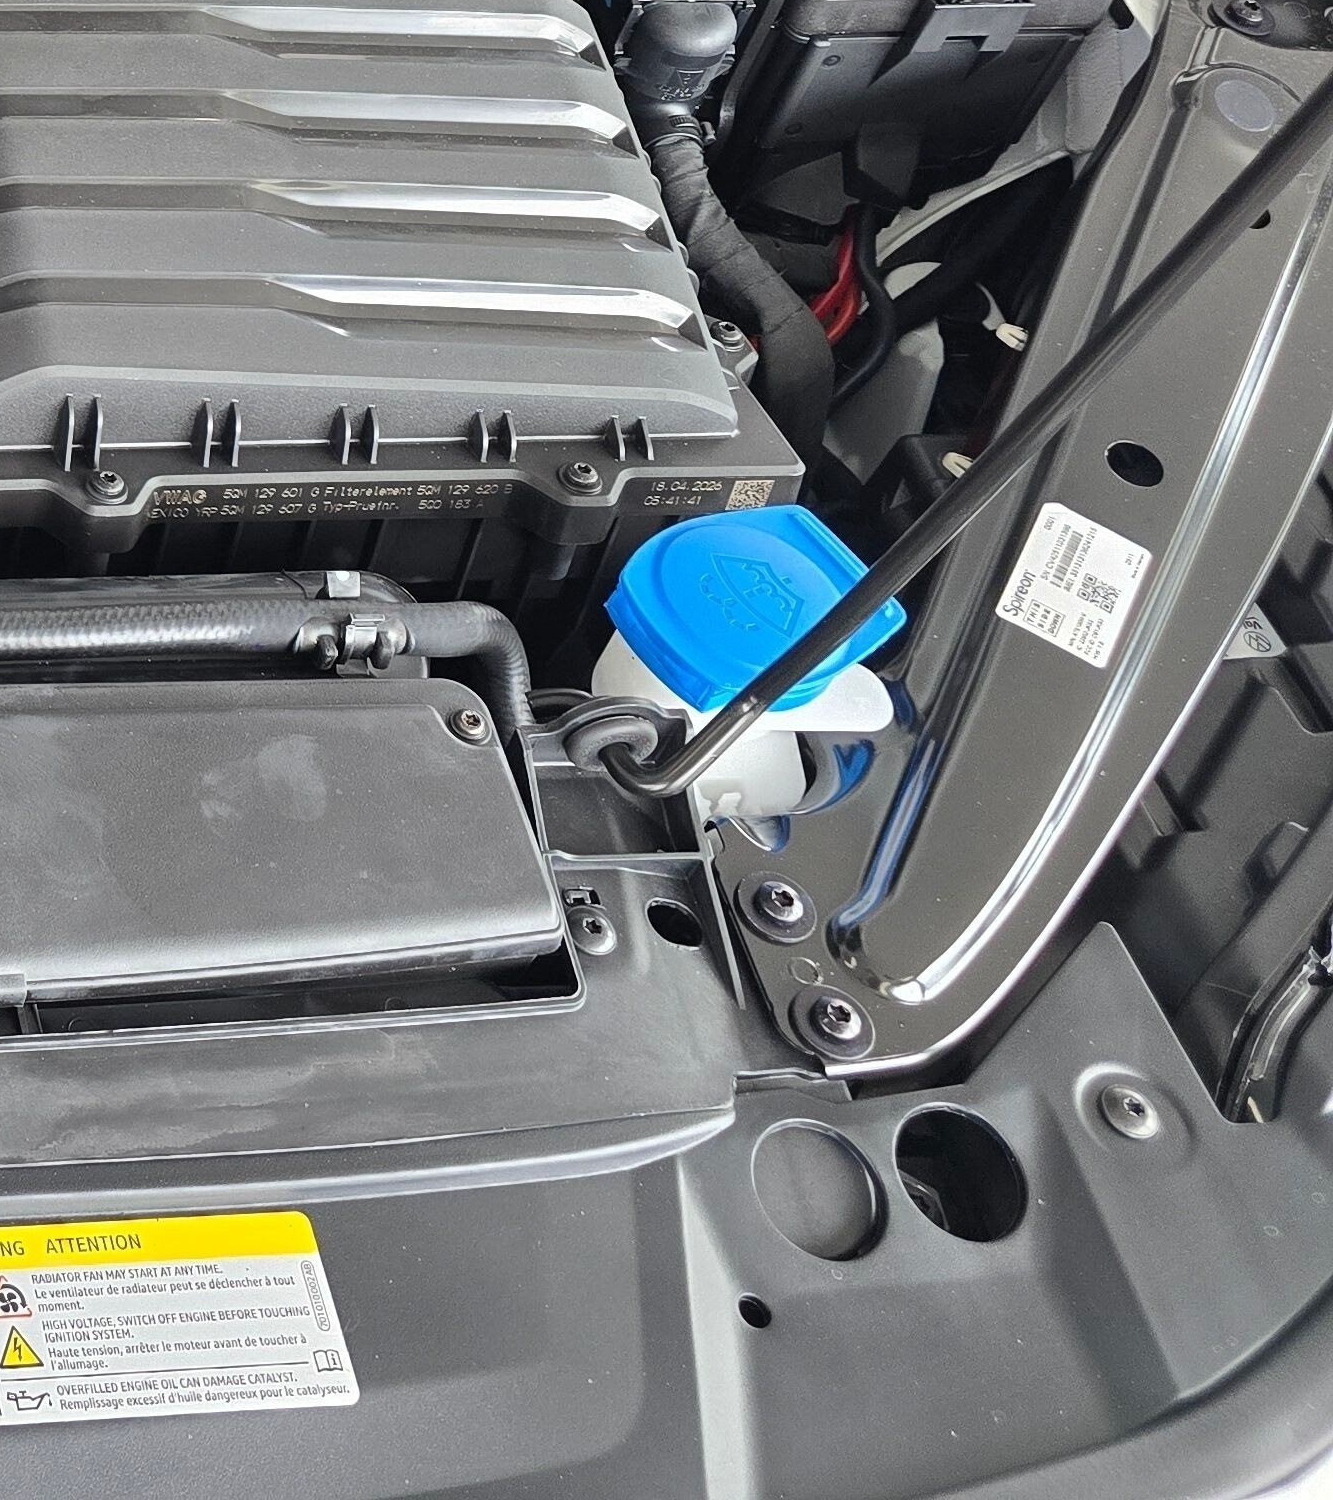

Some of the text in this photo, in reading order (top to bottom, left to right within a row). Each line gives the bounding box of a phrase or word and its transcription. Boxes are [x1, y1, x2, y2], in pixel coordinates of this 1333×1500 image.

[150, 489, 207, 506] VWAG
[255, 487, 276, 499] 129
[281, 487, 303, 498] 601
[311, 486, 320, 498] G
[323, 484, 413, 499] Filterelement
[448, 484, 470, 495] 129
[475, 484, 498, 494] 620
[644, 495, 702, 506] 05:41:41
[252, 503, 273, 515] 129
[278, 503, 302, 514] 607
[307, 503, 317, 514] G
[1001, 567, 1037, 618] Spireon
[1026, 602, 1040, 623] THIS
[1036, 607, 1051, 628] SIDE
[1047, 612, 1061, 634] DOWN
[46, 1234, 142, 1254] ATTENTION
[31, 1264, 223, 1284] RADIATOR FAN MAY START AT ANY TIME.
[34, 1275, 295, 1299] Le ventilateur de radiateur peut se déclencher à tout
[38, 1300, 85, 1312] moment.
[41, 1306, 310, 1331] HIGH VOLTAGE, SWITCH OFF ENGINE BEFORE TOUCHING
[44, 1328, 134, 1343] IGNITION SYSTEM.
[47, 1333, 307, 1358] Haute tension, arrêter le moteur avant de toucher à
[50, 1359, 109, 1371] l'allumage.
[56, 1371, 298, 1396] OVERFILLED ENGINE OIL CAN DAMAGE CATALYST.
[59, 1384, 350, 1411] Remplissage excessif d'huile dangereux pour le catalyseur.
